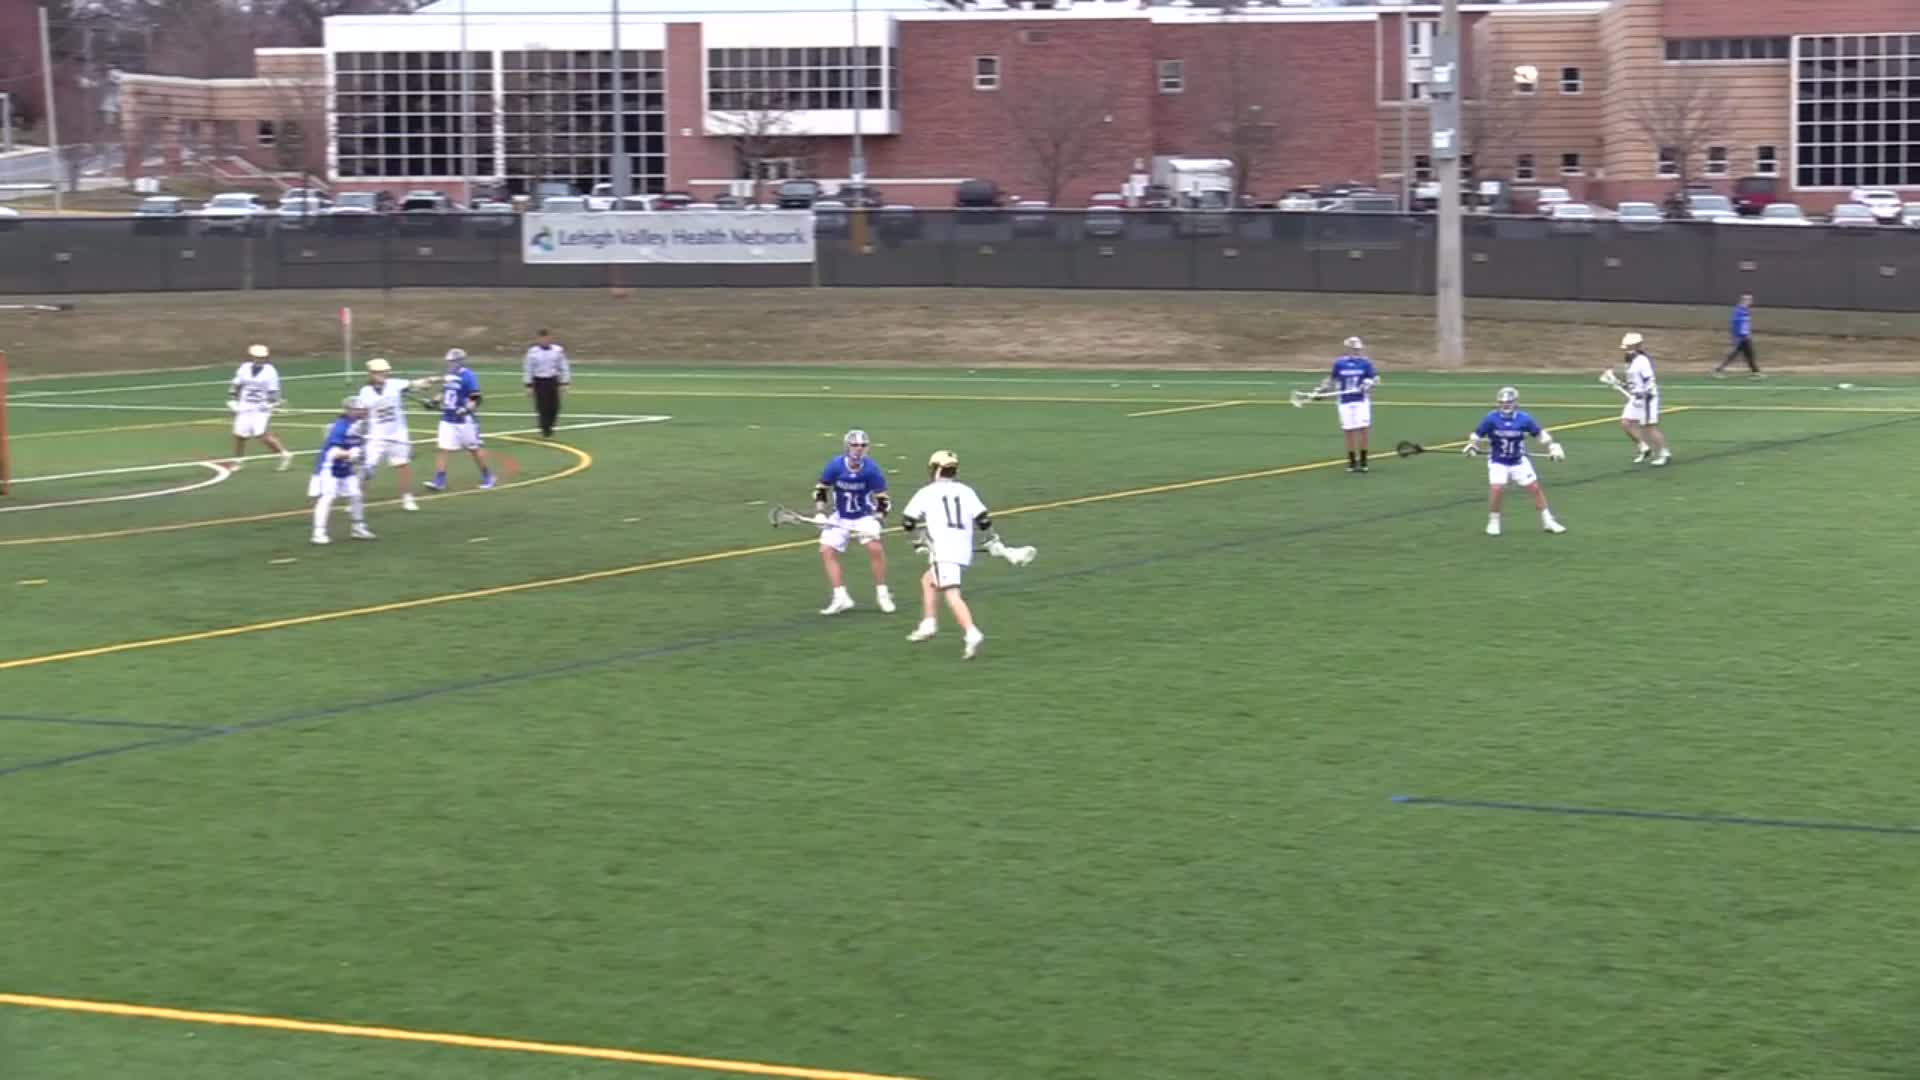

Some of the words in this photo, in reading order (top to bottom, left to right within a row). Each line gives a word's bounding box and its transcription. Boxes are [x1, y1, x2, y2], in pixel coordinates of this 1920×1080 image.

[558, 228, 615, 249] Lehigh
[616, 228, 668, 248] Valley
[671, 228, 727, 245] Health
[728, 227, 807, 245] Network
[941, 495, 966, 530] 11
